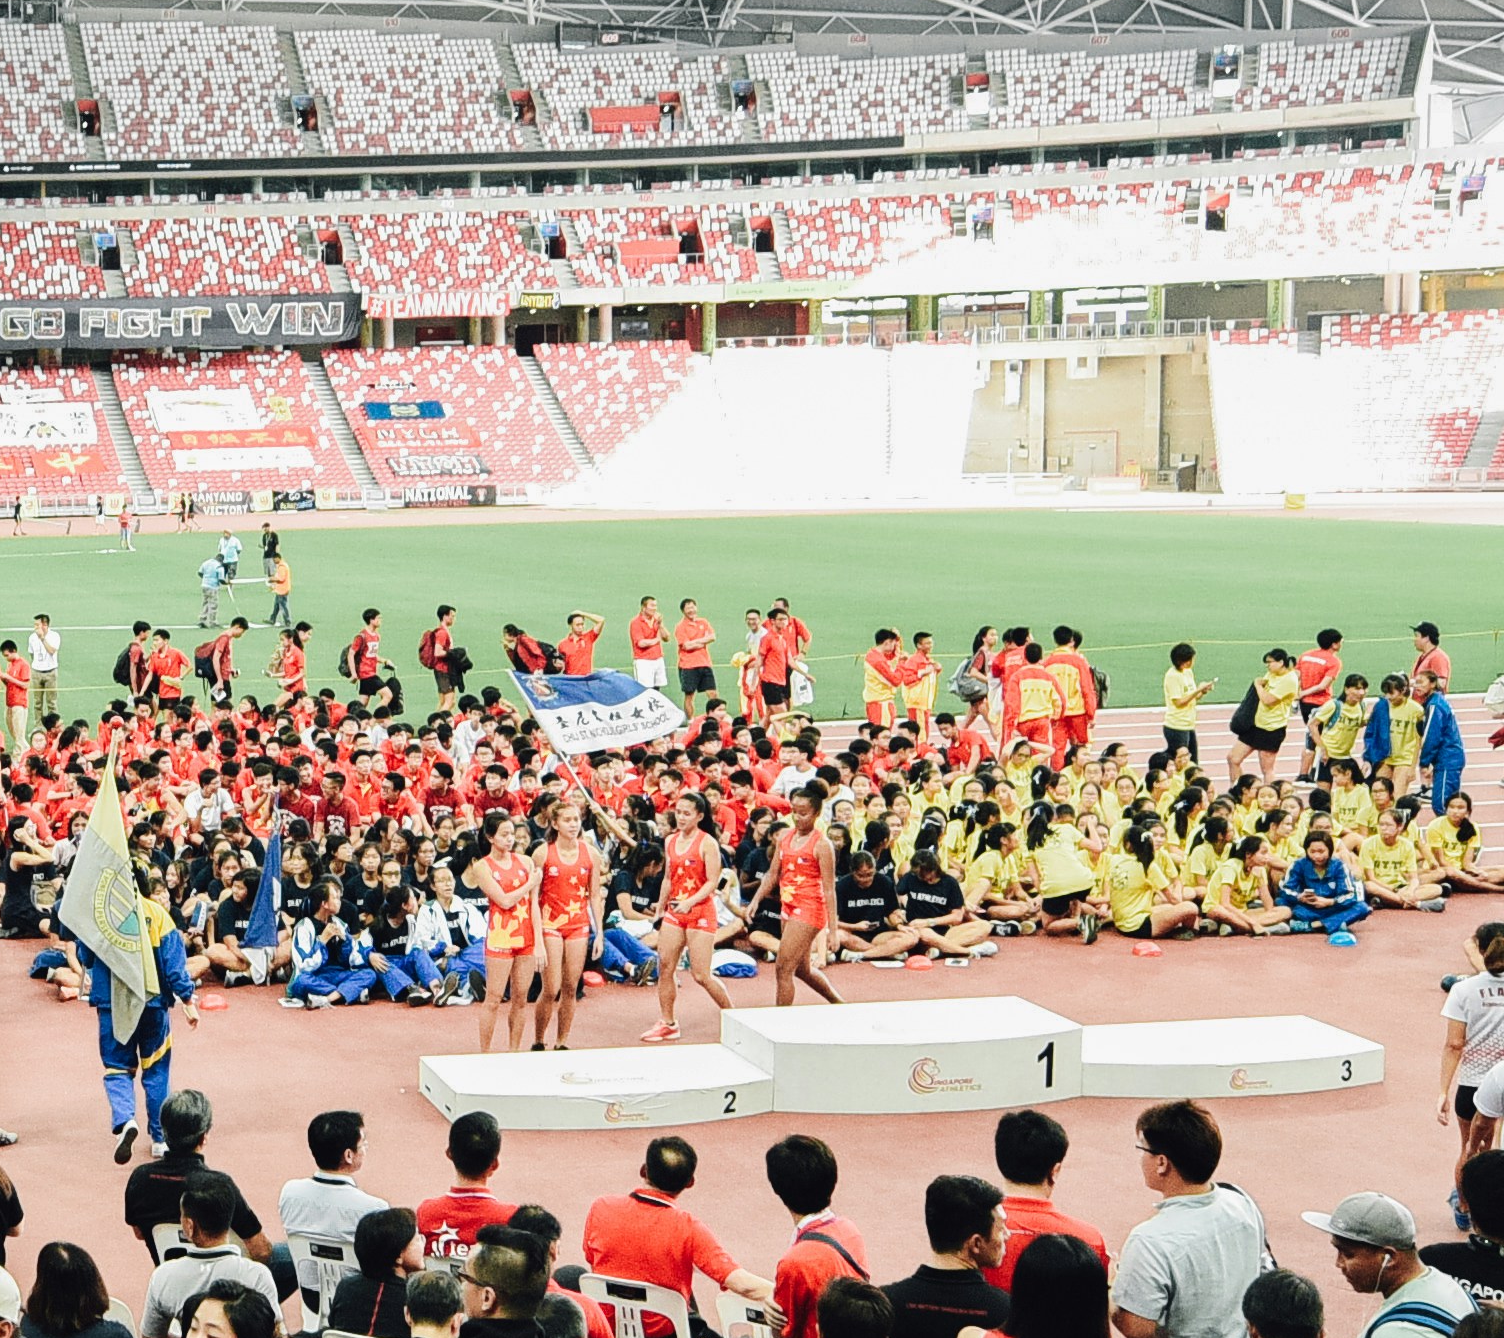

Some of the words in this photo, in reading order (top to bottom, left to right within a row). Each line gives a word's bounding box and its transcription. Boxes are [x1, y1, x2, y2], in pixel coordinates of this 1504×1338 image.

[164, 10, 175, 18] 611
[1091, 36, 1108, 44] 607
[1331, 29, 1349, 38] 606
[204, 205, 216, 214] 411
[367, 293, 507, 317] #TEAMNANYANG
[0, 307, 65, 341] GO
[79, 306, 212, 339] FIGHT
[226, 300, 345, 336] WIN
[405, 487, 472, 501] NATIONAL
[202, 504, 249, 515] VICTORY
[1037, 1041, 1055, 1088] 1
[1340, 1059, 1352, 1081] 3
[723, 1090, 737, 1114] 2
